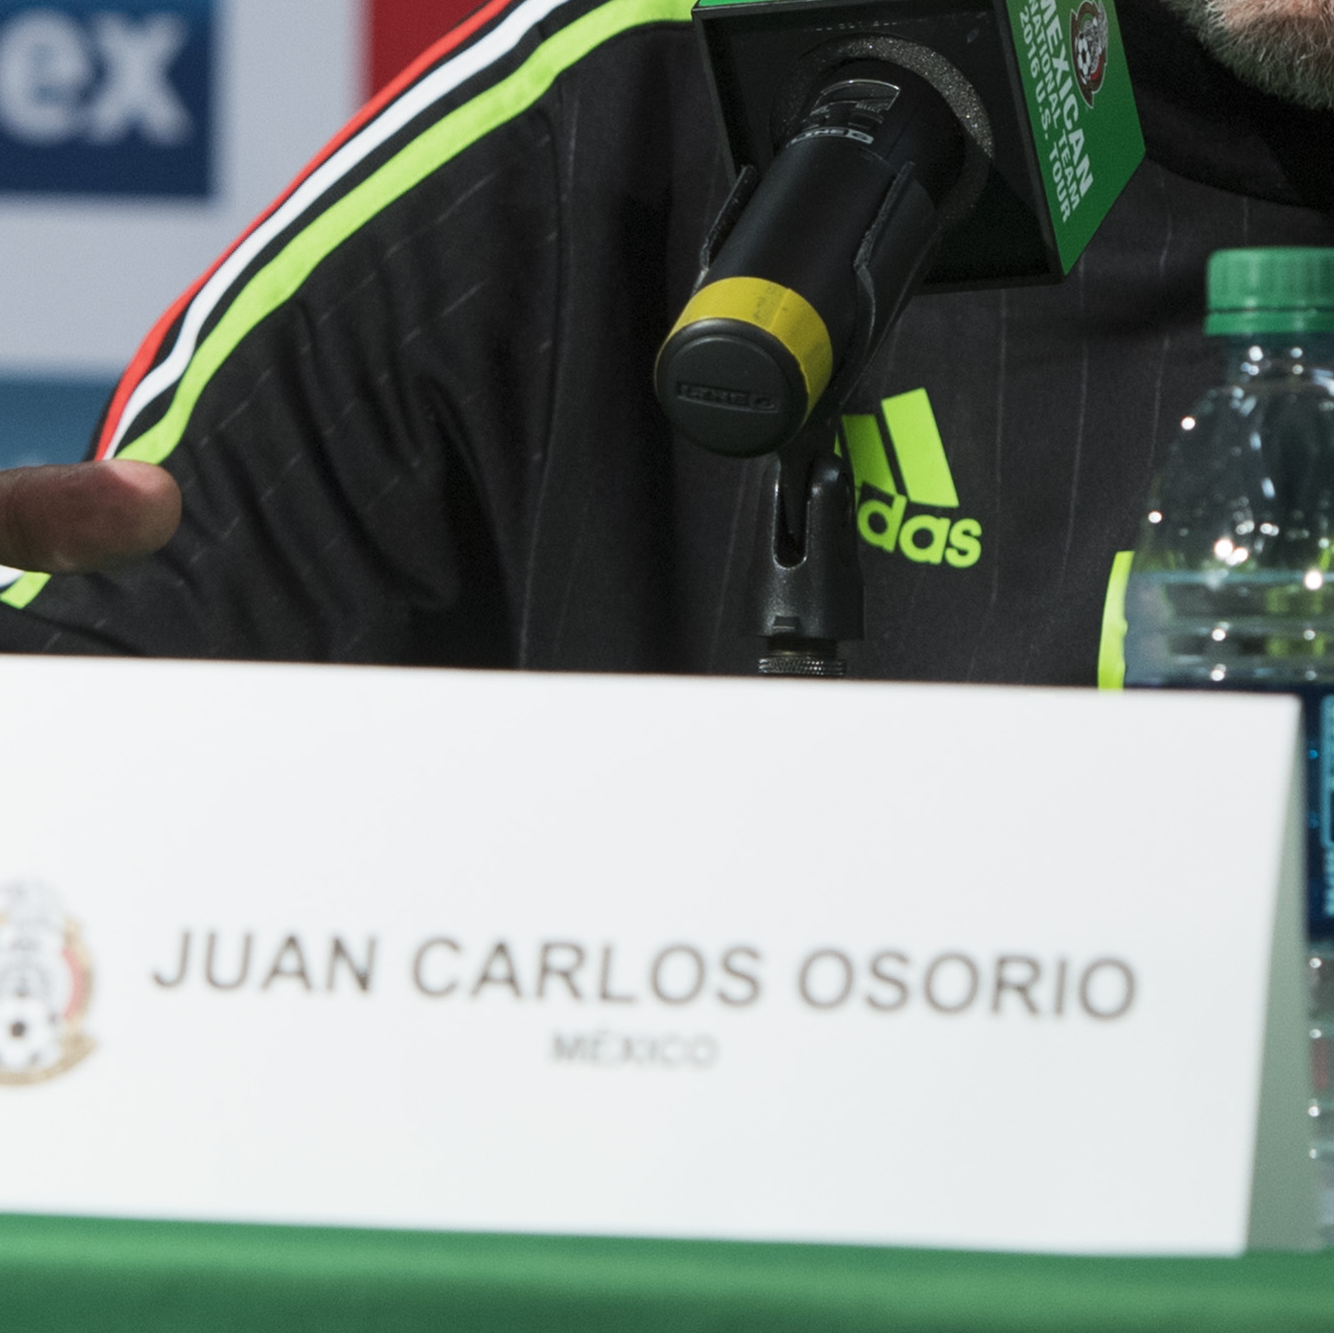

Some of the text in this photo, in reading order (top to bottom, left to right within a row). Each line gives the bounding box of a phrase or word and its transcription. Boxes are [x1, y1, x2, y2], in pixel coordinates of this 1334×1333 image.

[1019, 5, 1070, 223] 2016 U.S. TOUR
[1057, 128, 1082, 212] TEAM
[856, 493, 983, 569] das
[152, 929, 1140, 1023] JUAN CARLOS OSORIO
